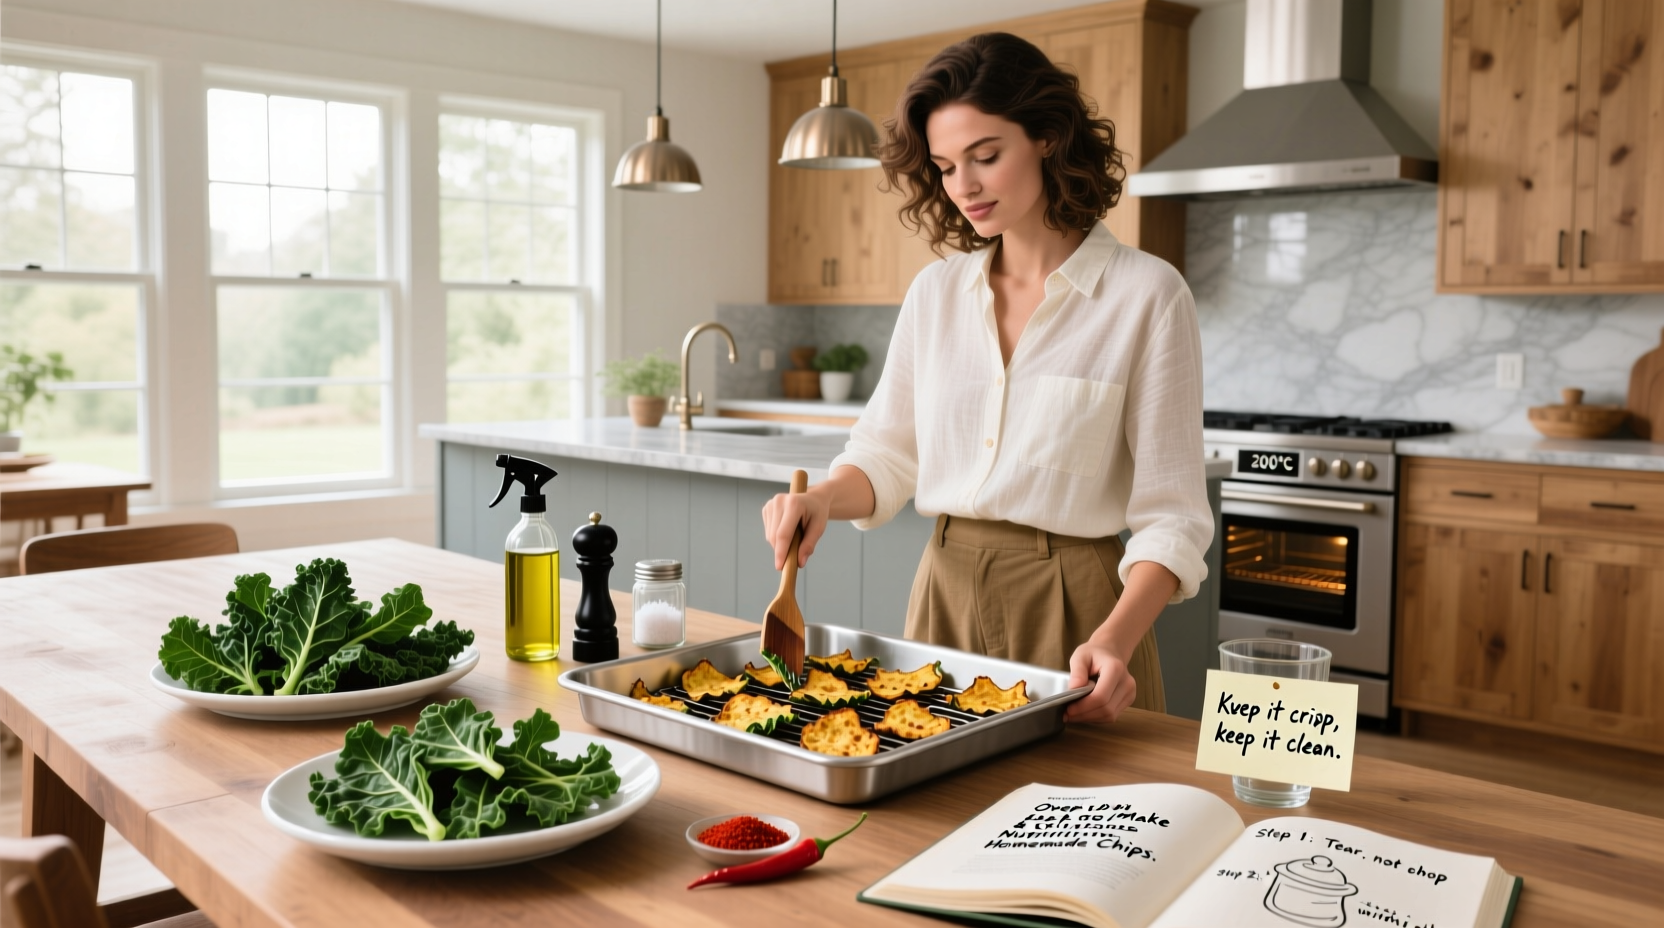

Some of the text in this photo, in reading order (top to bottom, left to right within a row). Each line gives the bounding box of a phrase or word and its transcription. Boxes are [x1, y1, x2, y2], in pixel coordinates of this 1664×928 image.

[1251, 454, 1293, 471] 200°C
[1267, 700, 1285, 721] it
[1215, 721, 1341, 759] keep it clean.
[1034, 803, 1083, 813] Over
[1096, 839, 1156, 862] Chips.
[1374, 854, 1402, 869] not
[1408, 865, 1448, 885] chop
